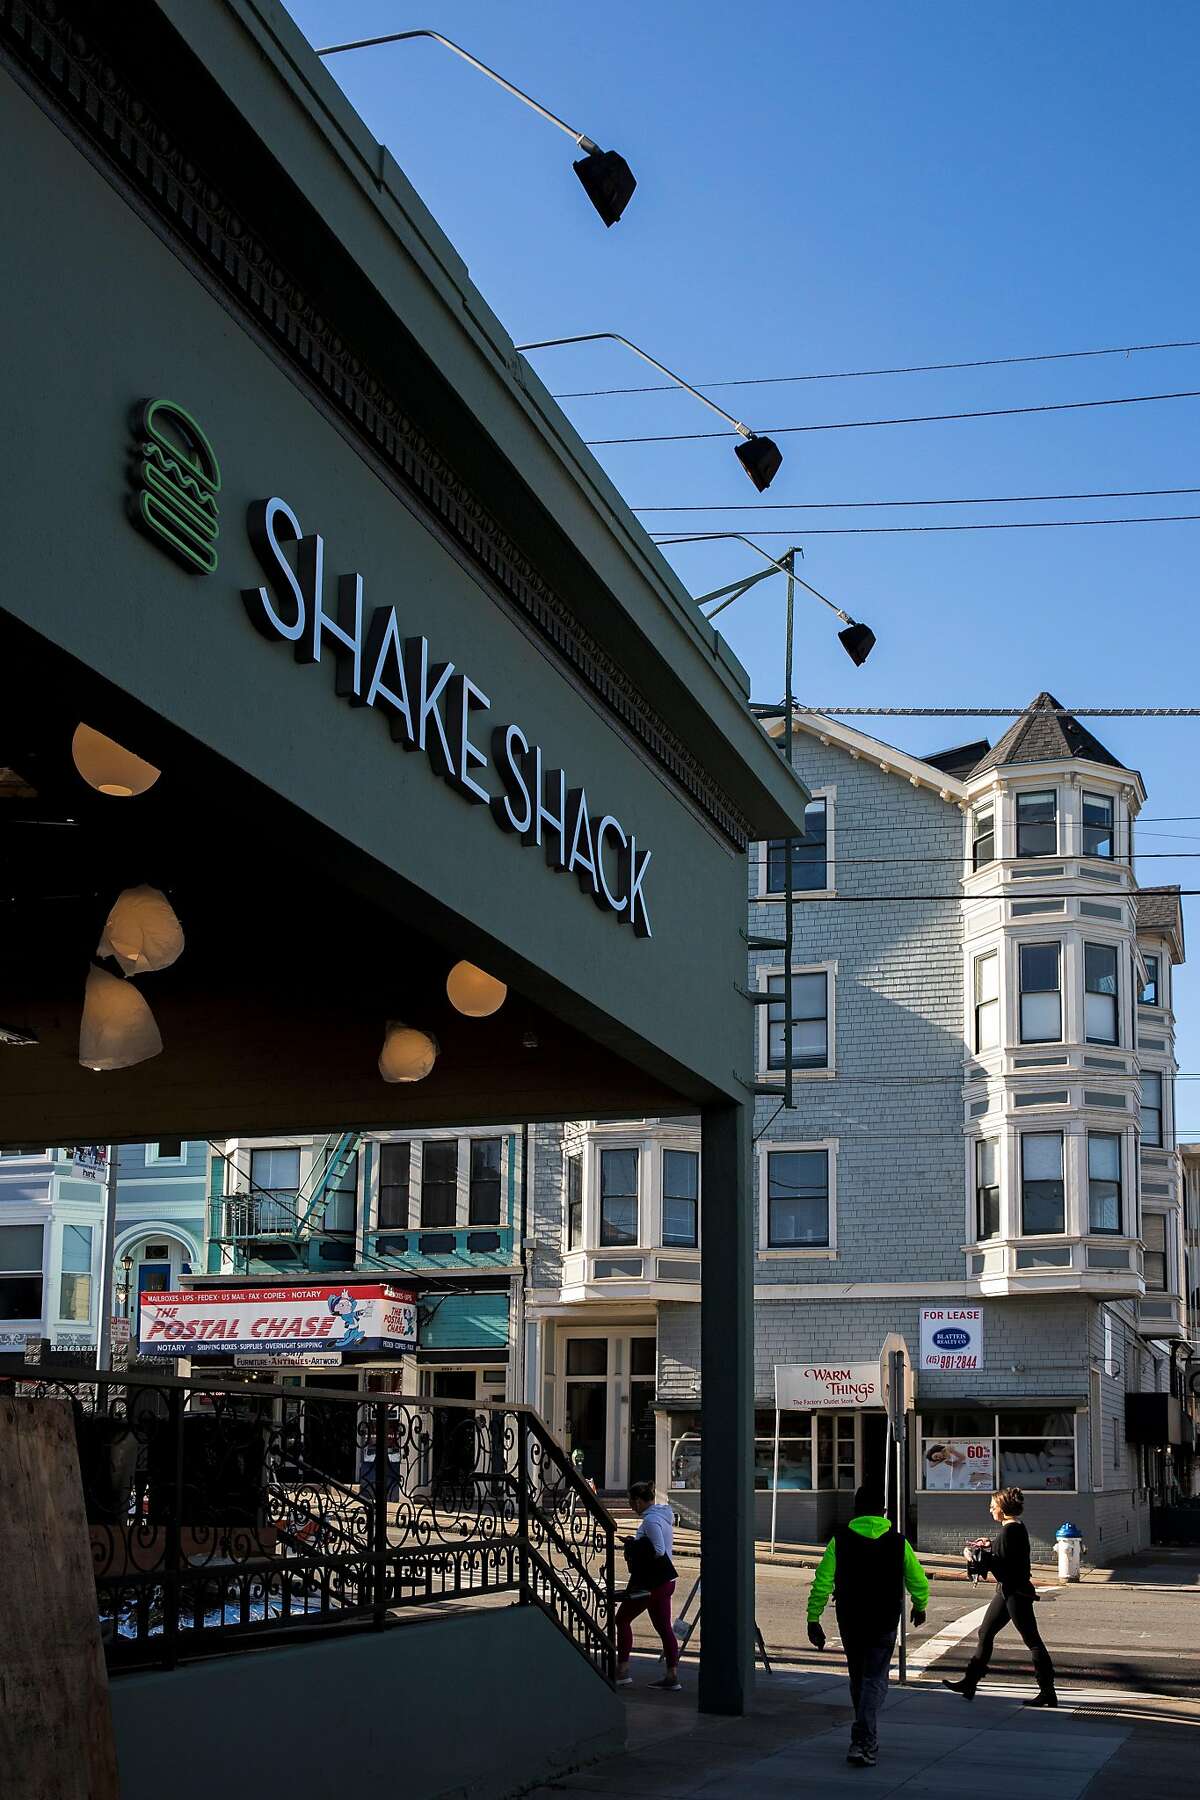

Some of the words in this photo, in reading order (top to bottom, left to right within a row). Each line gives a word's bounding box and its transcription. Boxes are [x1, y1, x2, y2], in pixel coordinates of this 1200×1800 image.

[250, 497, 490, 805] SHAKE
[497, 725, 653, 939] SHACK
[291, 1291, 322, 1299] NOTARY
[155, 1307, 179, 1319] THE
[392, 1307, 402, 1316] THE
[924, 1311, 944, 1320] FOR
[947, 1311, 980, 1320] LEASE
[384, 1314, 404, 1325] POSTAL
[146, 1319, 240, 1340] POSTAL
[250, 1316, 337, 1338] CHASE
[387, 1324, 405, 1334] CHASE
[157, 1343, 186, 1352] NOTARY
[197, 1343, 220, 1351] SHIPPING
[220, 1343, 238, 1351] BOXES
[297, 1341, 323, 1349] SHIPPING
[236, 1357, 269, 1366] FURNITURE
[271, 1357, 309, 1366] ANTIQUES
[310, 1356, 339, 1365] ARTWORK
[925, 1354, 940, 1365] (415)
[940, 1355, 978, 1369] 981-2844
[804, 1369, 852, 1381] WARM
[826, 1382, 875, 1403] THINGS
